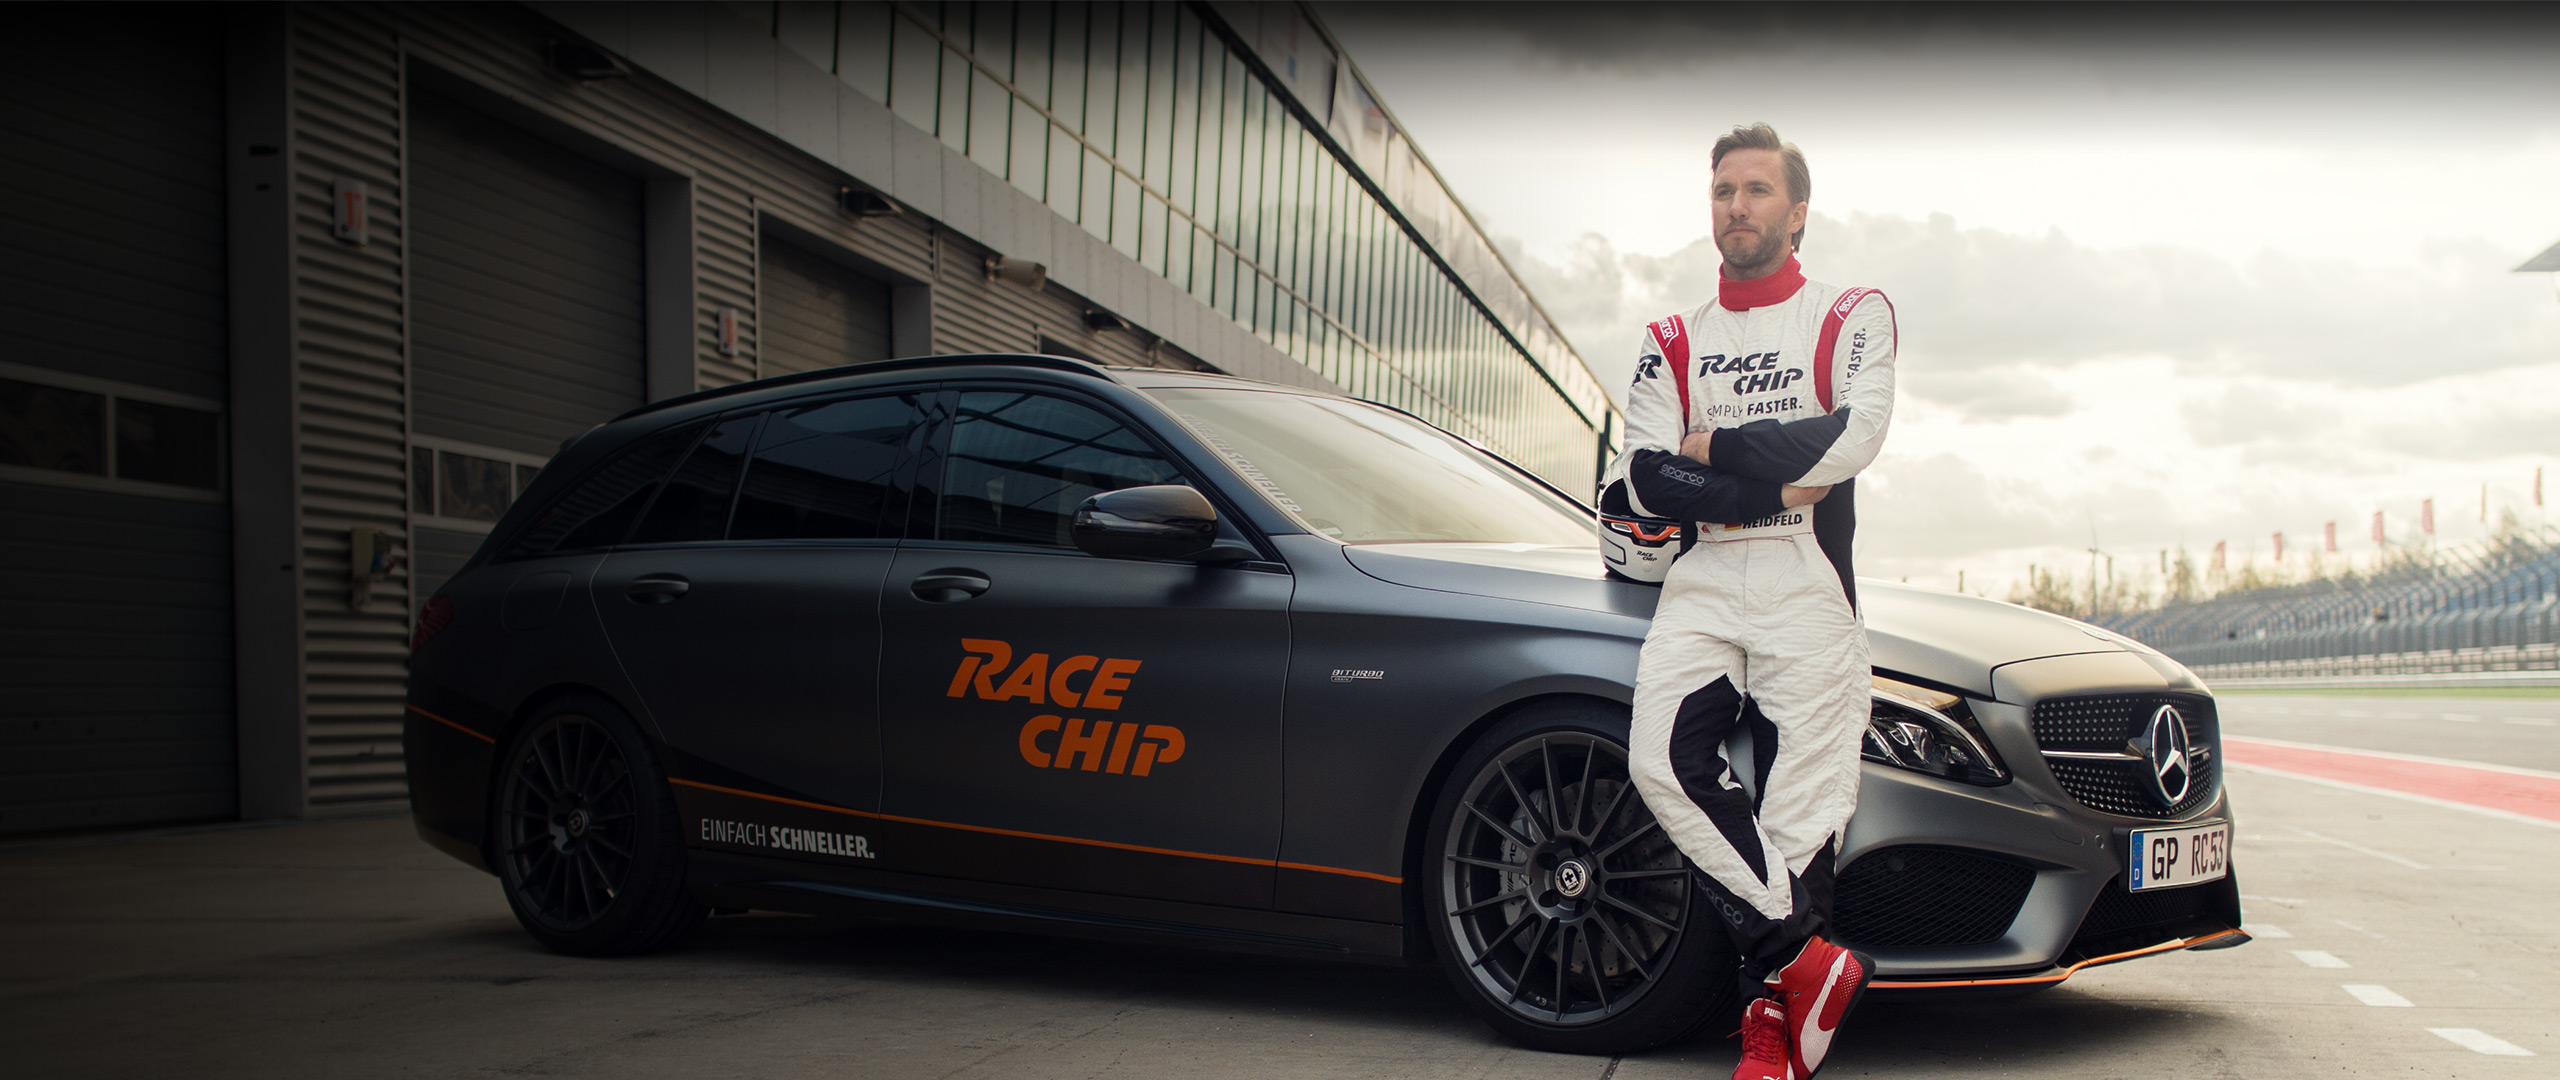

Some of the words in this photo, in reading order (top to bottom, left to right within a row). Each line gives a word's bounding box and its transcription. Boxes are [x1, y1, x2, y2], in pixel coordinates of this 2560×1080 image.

[343, 190, 364, 229] 17
[1838, 287, 1867, 312] sparc
[1699, 351, 1780, 378] RACE
[1847, 328, 1867, 379] FASTER.
[1733, 368, 1804, 395] CHIP
[1706, 405, 1743, 421] SMPLY
[1747, 397, 1803, 416] FASTER.
[1659, 463, 1705, 486] sparco
[946, 637, 1143, 710] RACE
[1332, 669, 1384, 677] BITURBO
[1019, 714, 1186, 777] CHIP
[701, 818, 766, 847] EINFACH
[770, 826, 875, 859] SCHNELLER.
[2134, 868, 2140, 881] D
[2151, 837, 2179, 880] GP
[1694, 876, 1744, 925] parco
